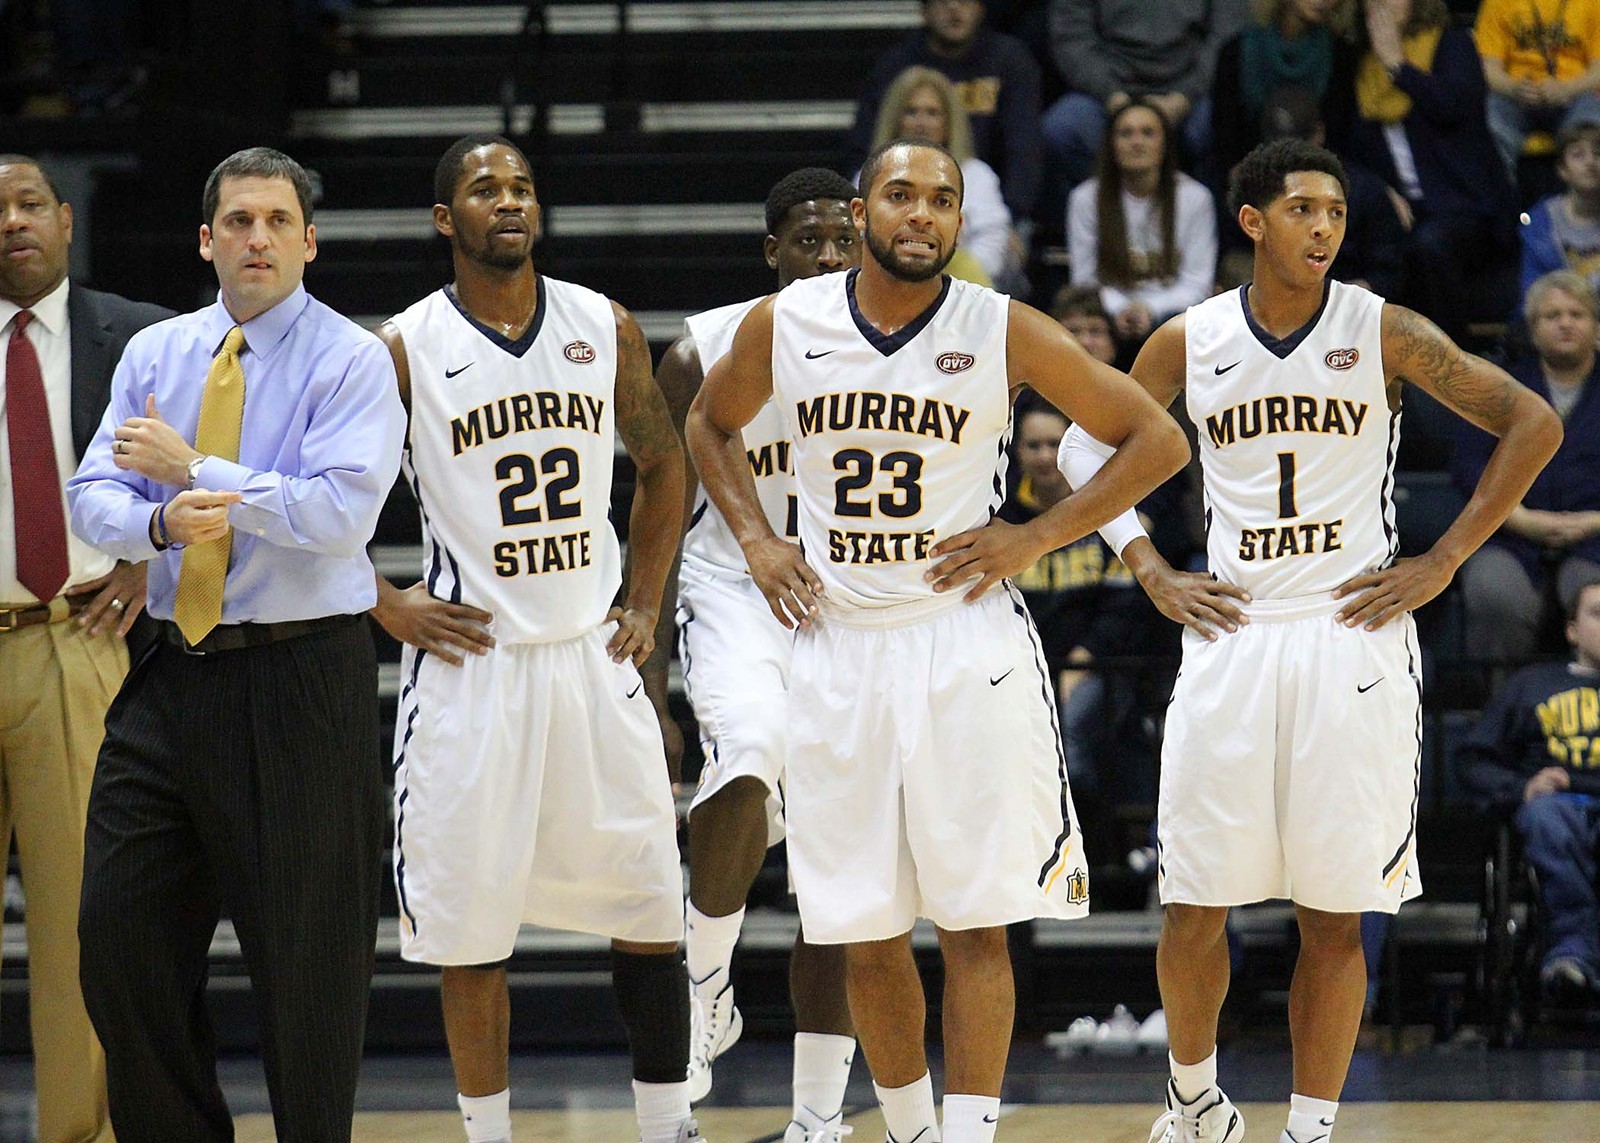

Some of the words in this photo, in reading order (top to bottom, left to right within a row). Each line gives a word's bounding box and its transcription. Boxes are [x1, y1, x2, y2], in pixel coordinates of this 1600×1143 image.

[450, 390, 604, 457] MURRAY
[797, 391, 971, 446] MURRAY
[1205, 394, 1368, 449] MURRAY
[495, 446, 582, 527] 22
[832, 447, 924, 520] 23
[1278, 451, 1299, 520] 1
[494, 530, 591, 578] STATE
[828, 528, 937, 565] STATE
[1239, 519, 1344, 562] STATE
[1536, 687, 1600, 736] MUR
